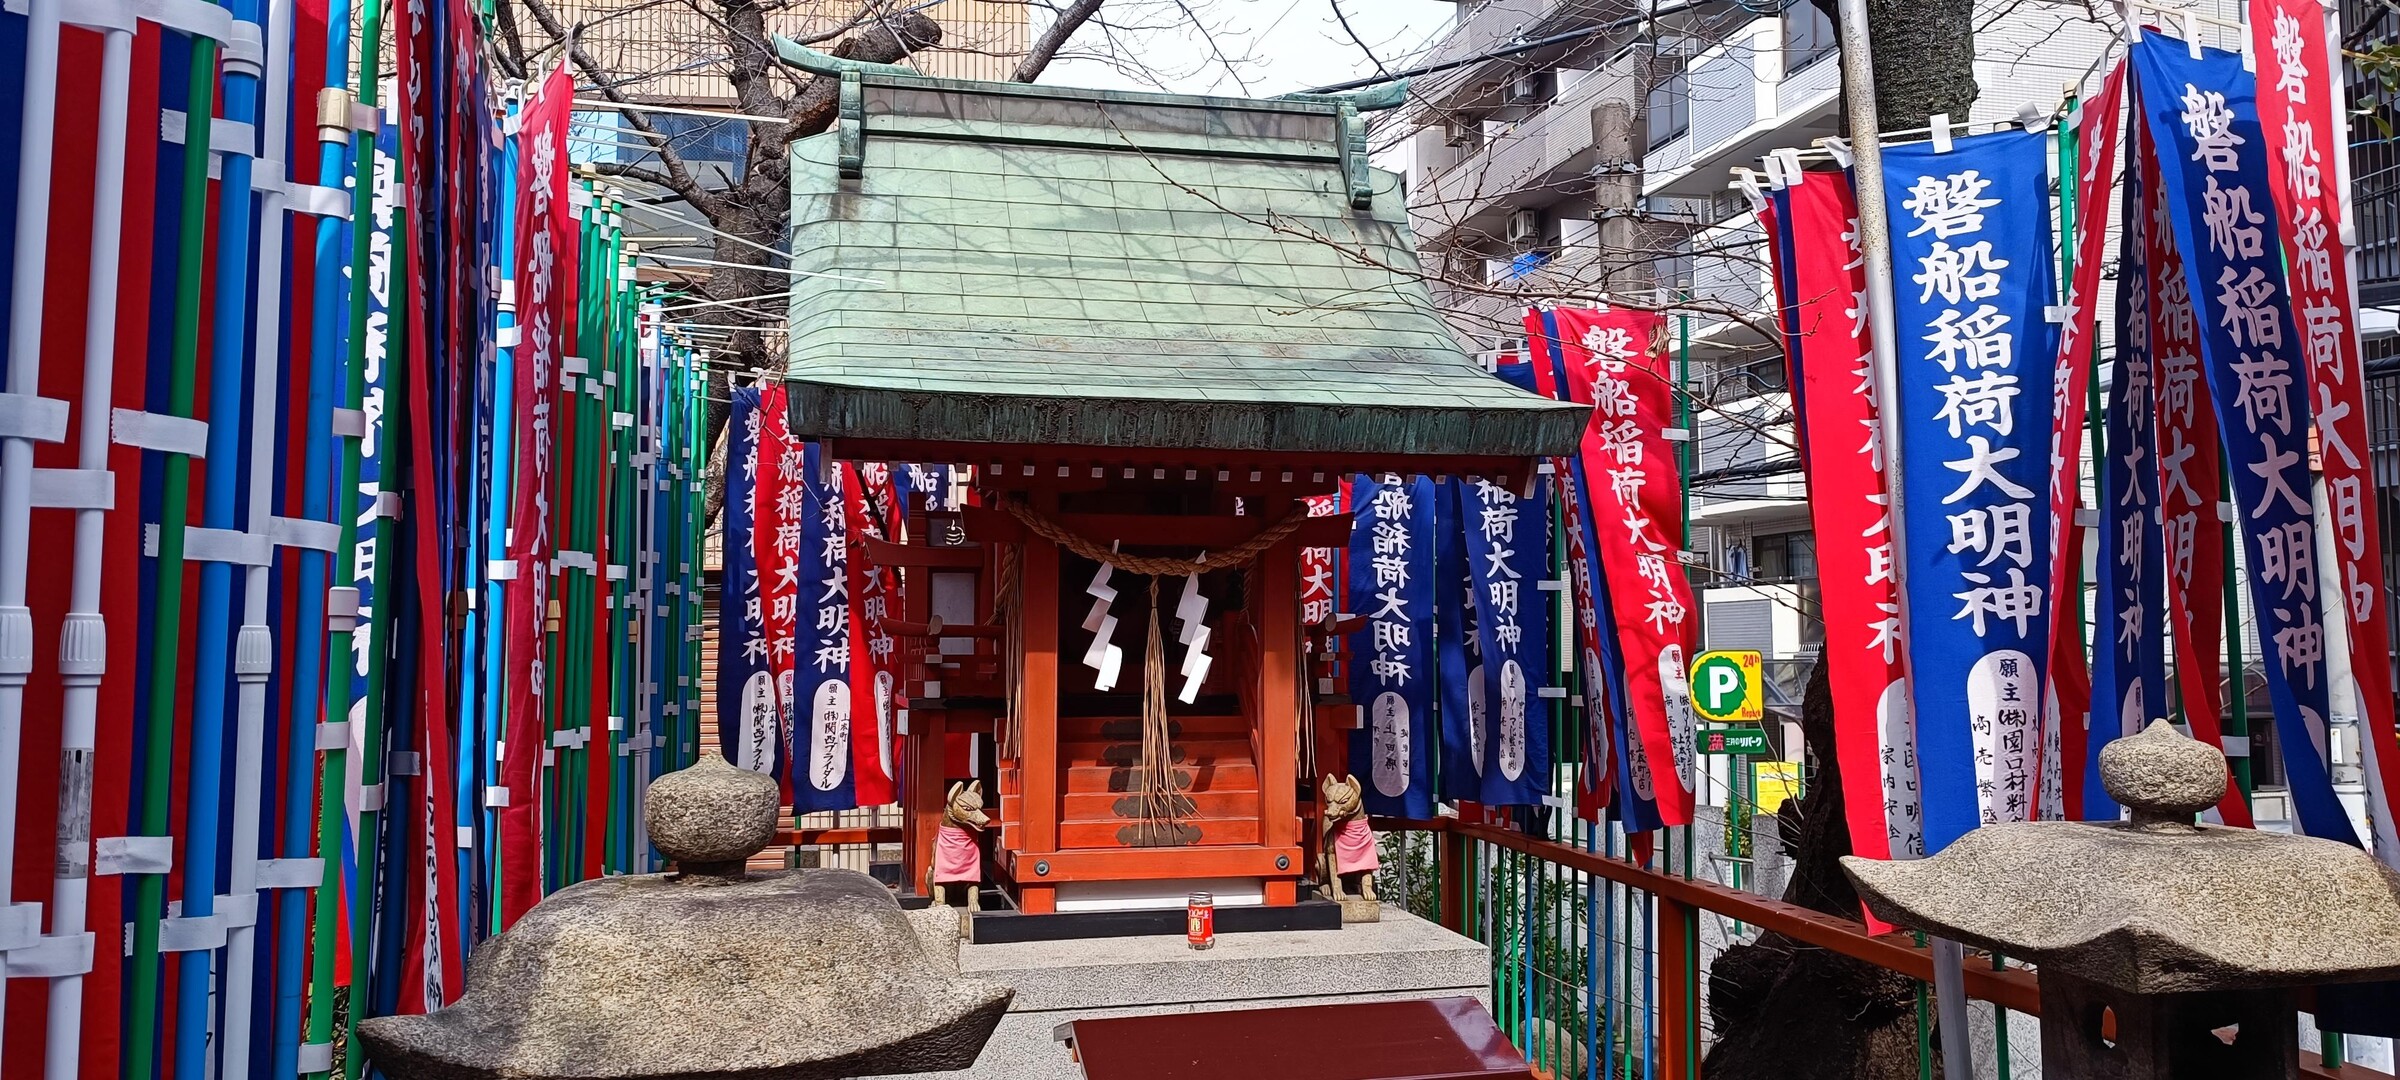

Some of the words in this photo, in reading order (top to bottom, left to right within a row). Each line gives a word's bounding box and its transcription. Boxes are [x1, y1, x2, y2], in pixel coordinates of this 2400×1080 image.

[1902, 170, 2043, 640] 磐船稲荷大明神
[2181, 83, 2323, 690] 磐船稲荷大明神
[1582, 325, 1686, 638] 磐船稲荷大明神
[827, 683, 838, 706] 願主
[1709, 666, 1740, 708] P
[1743, 655, 1760, 667] 24h
[1999, 658, 2021, 702] 願主
[1881, 745, 1902, 840] 家内安全
[1972, 714, 1998, 825] 商売繁盛
